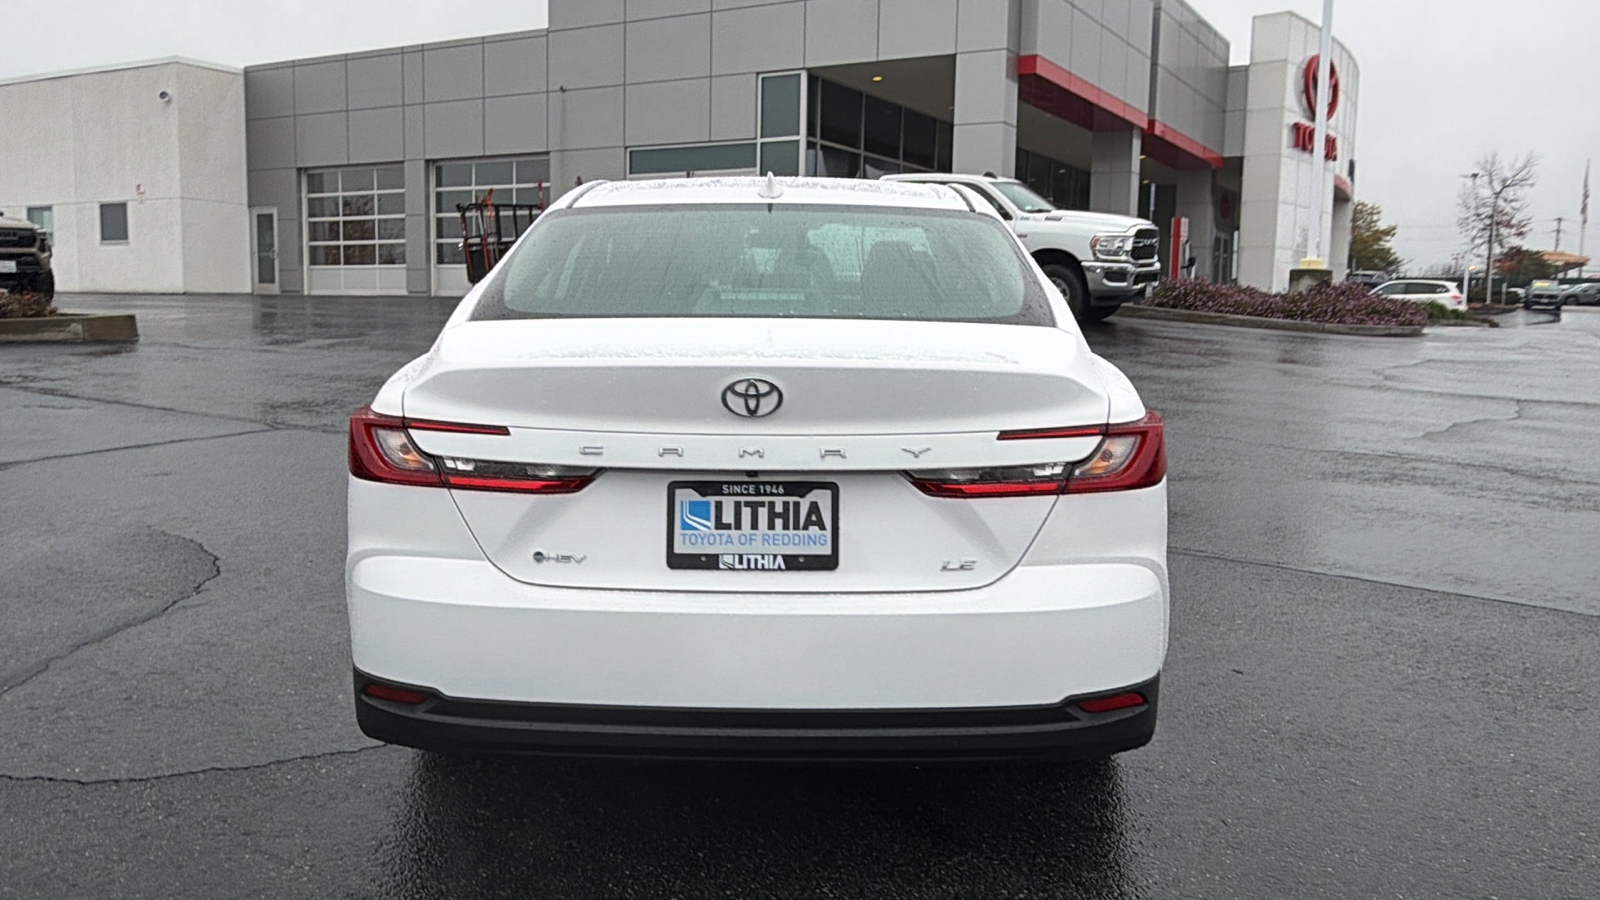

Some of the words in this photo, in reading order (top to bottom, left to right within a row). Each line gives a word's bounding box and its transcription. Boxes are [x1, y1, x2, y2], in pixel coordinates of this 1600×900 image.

[579, 445, 932, 459] CAMRY
[722, 484, 756, 495] SINCE
[759, 484, 785, 495] 1946
[714, 500, 827, 531] LITHIA
[680, 533, 734, 547] TOYOTA
[738, 533, 757, 547] OF
[762, 533, 828, 547] REDDING
[734, 554, 786, 570] LITHIA
[940, 560, 977, 571] LE
